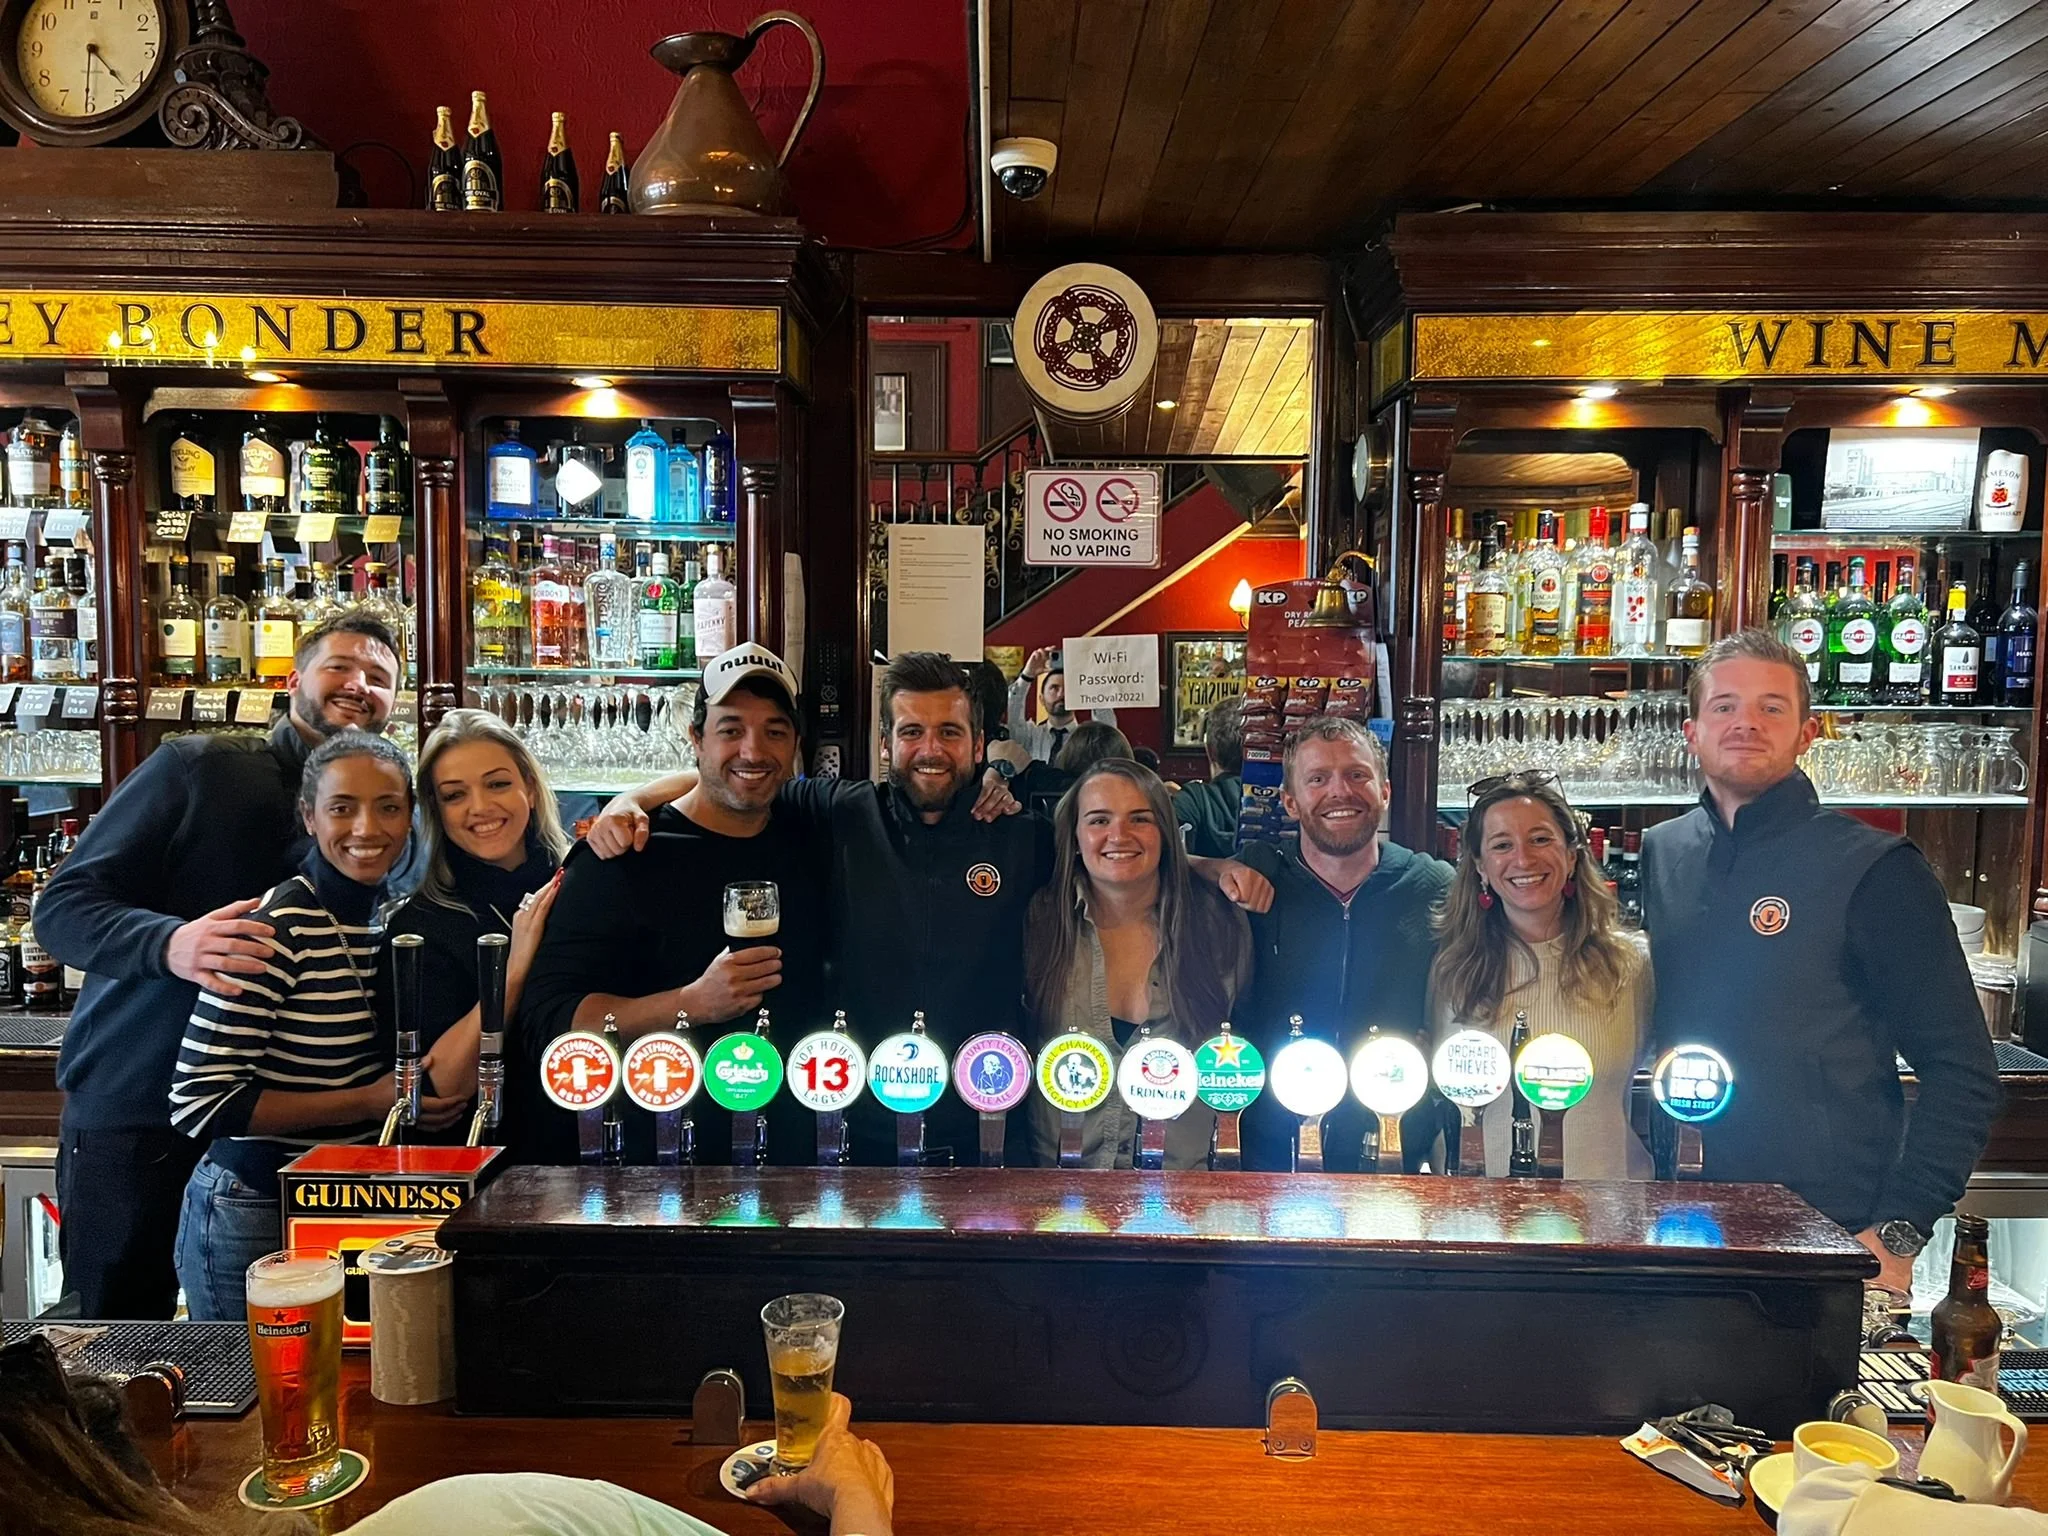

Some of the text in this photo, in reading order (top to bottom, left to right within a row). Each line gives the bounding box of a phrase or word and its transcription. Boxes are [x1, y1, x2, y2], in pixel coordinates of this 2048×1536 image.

[41, 12, 57, 31] 10
[137, 14, 149, 31] 2
[31, 41, 43, 58] 9
[144, 42, 156, 59] 3
[39, 69, 51, 87] 8
[131, 70, 144, 87] 4
[59, 89, 69, 107] 7
[85, 95, 96, 113] 6
[114, 89, 125, 105] 5
[115, 302, 492, 356] BONDER
[1728, 320, 1957, 369] WINE
[1043, 528, 1139, 541] NO SMOKING
[1050, 545, 1131, 557] NO VAPING
[1258, 592, 1286, 604] KP
[1284, 611, 1301, 619] DRY
[1094, 651, 1127, 664] Wi-Fi
[1079, 672, 1144, 686] Password:
[1080, 692, 1144, 704] TheOval2022!
[795, 1041, 857, 1070] HOP HOUSE
[963, 1040, 992, 1065] AUNTY
[1043, 1051, 1058, 1070] BILL
[1448, 1045, 1497, 1059] ORCHARD
[715, 1060, 769, 1085] Carlsberg
[802, 1057, 849, 1091] 13
[875, 1064, 939, 1084] ROCKSHORE
[1448, 1059, 1497, 1075] THIEVES
[558, 1084, 606, 1102] RED ALE
[637, 1087, 686, 1104] RED ALE
[804, 1090, 847, 1104] LAGER
[971, 1090, 1012, 1104] PALE ALE
[1044, 1078, 1108, 1108] LEGACY LAGER
[1130, 1085, 1186, 1101] ERDINGER
[296, 1184, 462, 1210] GUINNESS
[257, 1323, 308, 1336] Heineken
